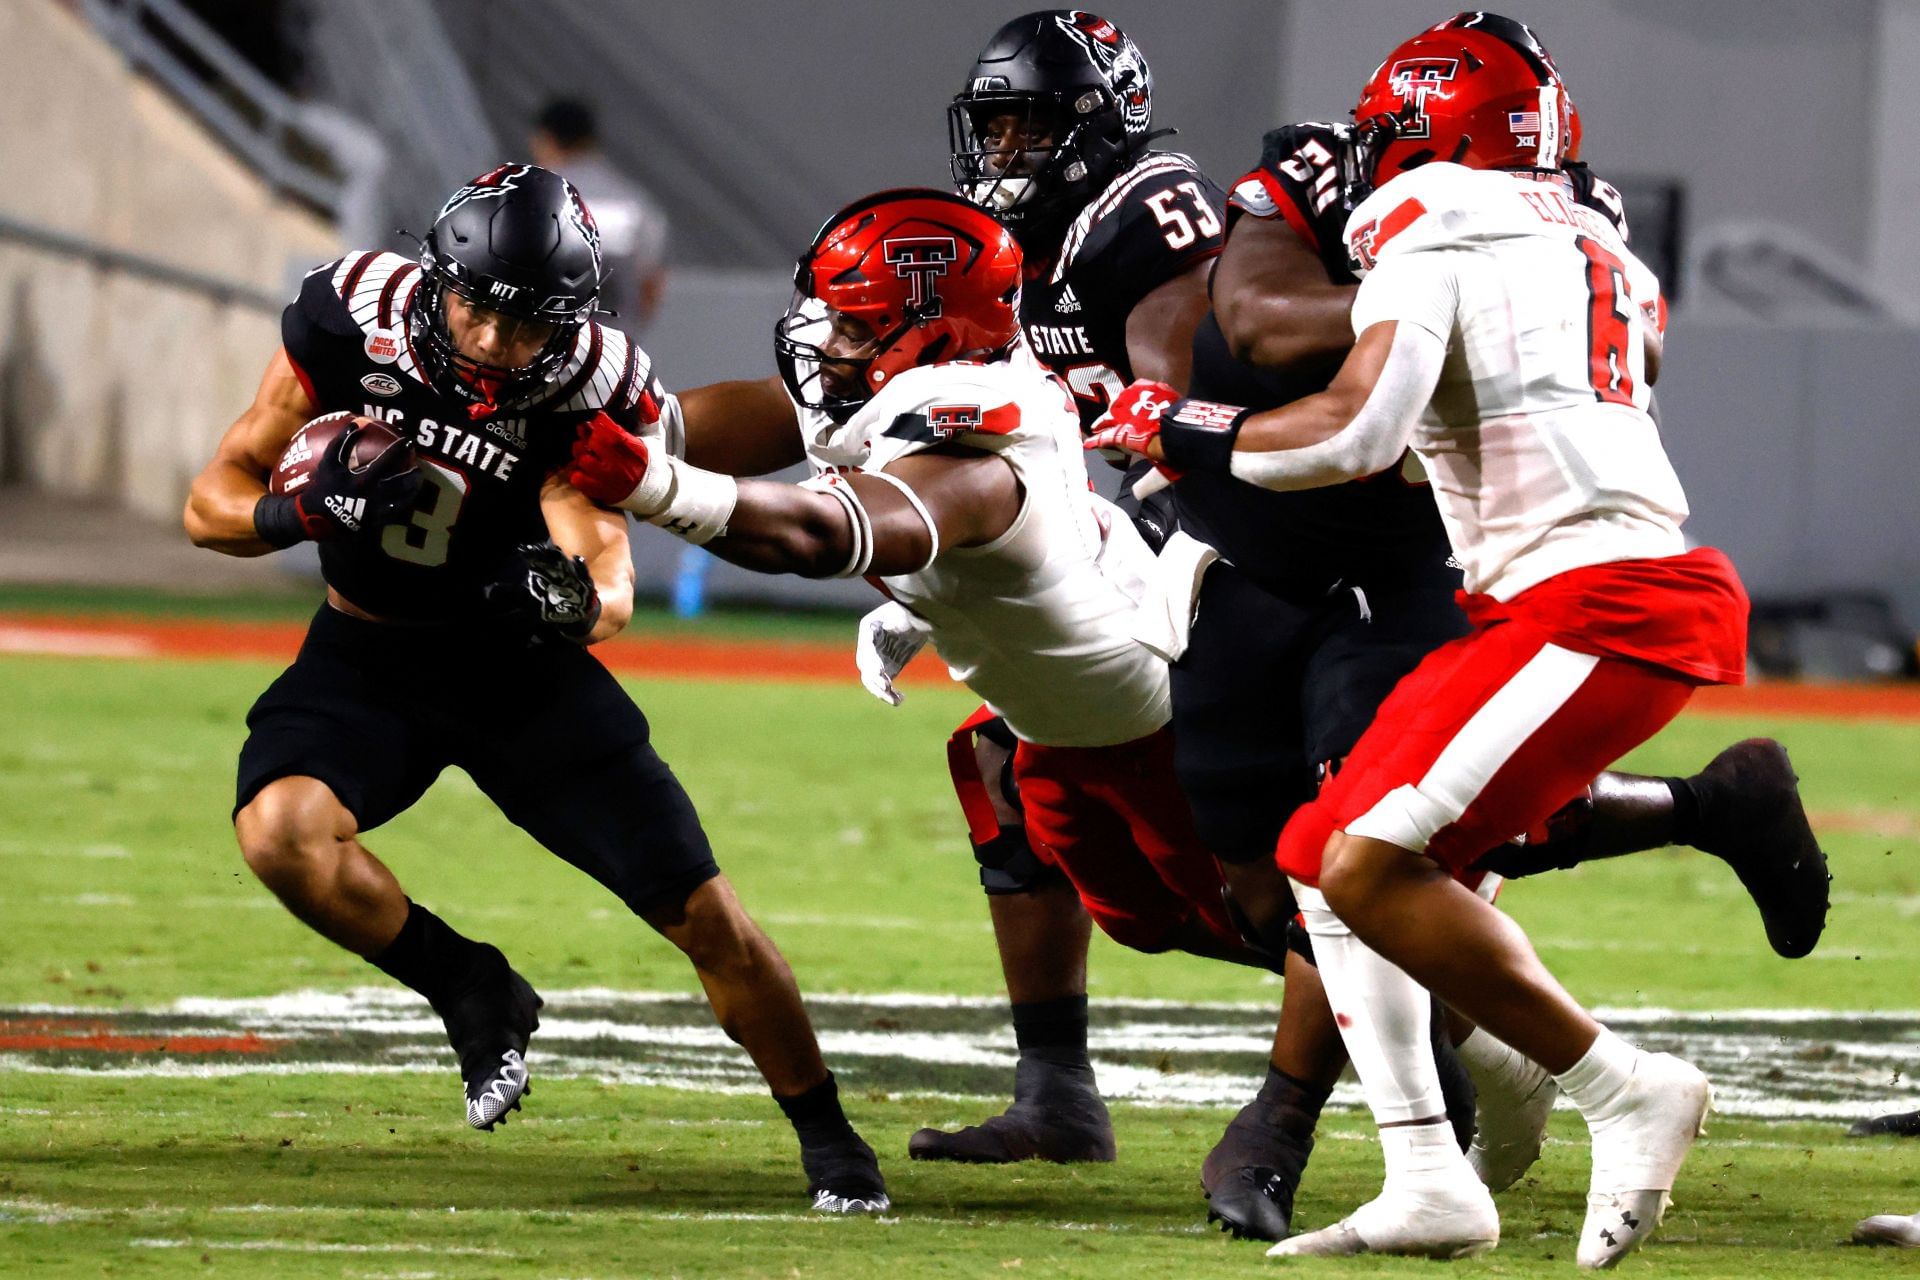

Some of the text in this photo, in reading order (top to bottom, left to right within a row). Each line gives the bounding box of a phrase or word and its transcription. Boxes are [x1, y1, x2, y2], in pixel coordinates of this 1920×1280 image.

[1144, 181, 1222, 249] 53
[490, 281, 519, 300] HTT
[1055, 301, 1082, 314] adidas
[1575, 235, 1638, 408] 6
[368, 345, 397, 357] UNITED
[373, 336, 395, 347] PACK
[1030, 324, 1094, 354] STATE
[368, 379, 396, 391] ACC
[416, 418, 520, 482] STATE
[485, 422, 528, 450] adidas
[324, 496, 361, 532] adidas
[381, 455, 470, 567] 3
